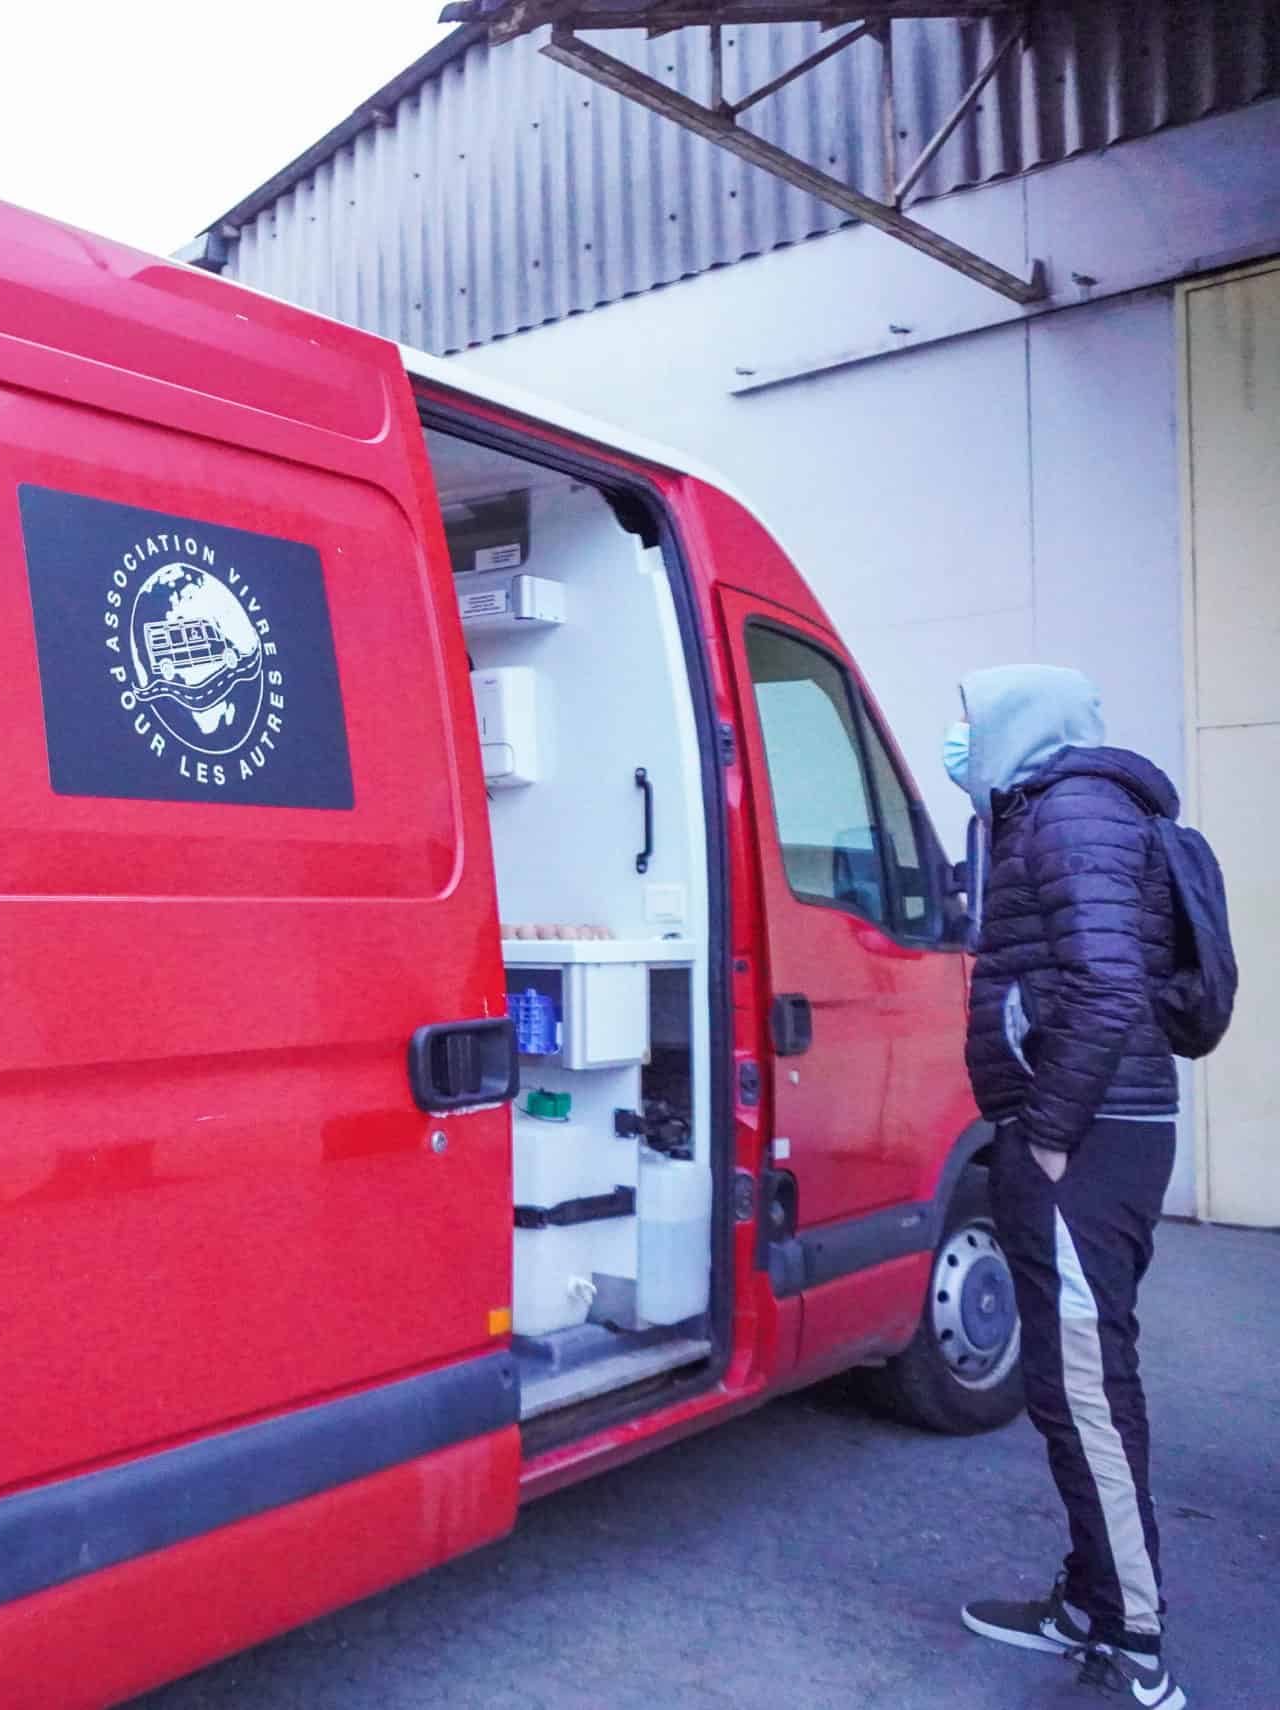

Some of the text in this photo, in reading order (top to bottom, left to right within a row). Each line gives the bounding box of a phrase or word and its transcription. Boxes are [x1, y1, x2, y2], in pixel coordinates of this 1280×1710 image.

[105, 534, 277, 656] ASSOCIATION VIVRE
[110, 666, 284, 785] POUR LES AUTRES
